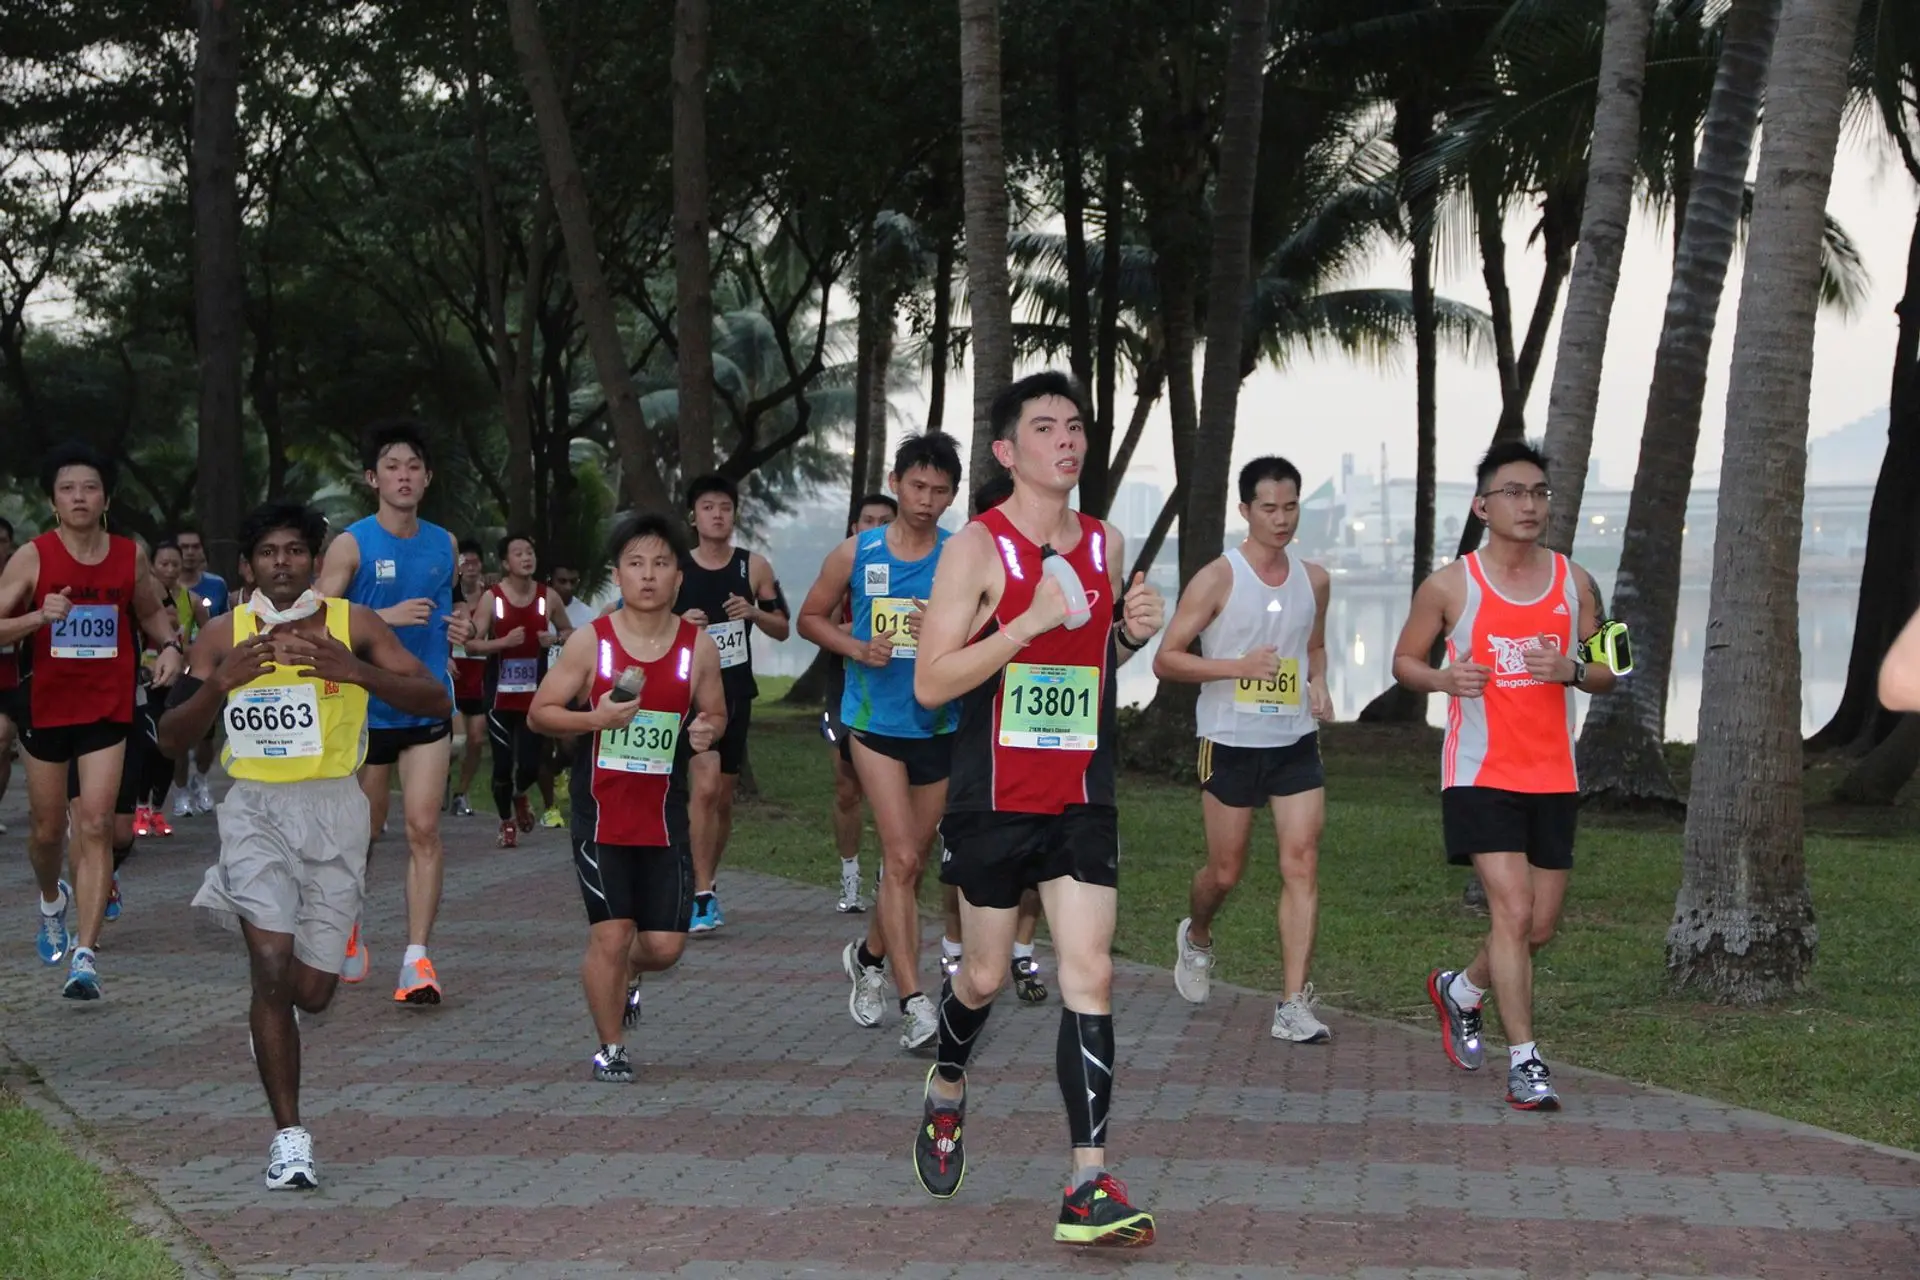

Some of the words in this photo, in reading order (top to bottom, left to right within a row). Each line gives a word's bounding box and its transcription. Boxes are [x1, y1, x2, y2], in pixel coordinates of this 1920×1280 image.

[55, 618, 115, 637] 21039
[501, 667, 535, 680] 21583
[1496, 678, 1545, 689] Singapo
[1011, 685, 1089, 718] 13801
[230, 703, 313, 731] 66663
[607, 726, 673, 750] 11330
